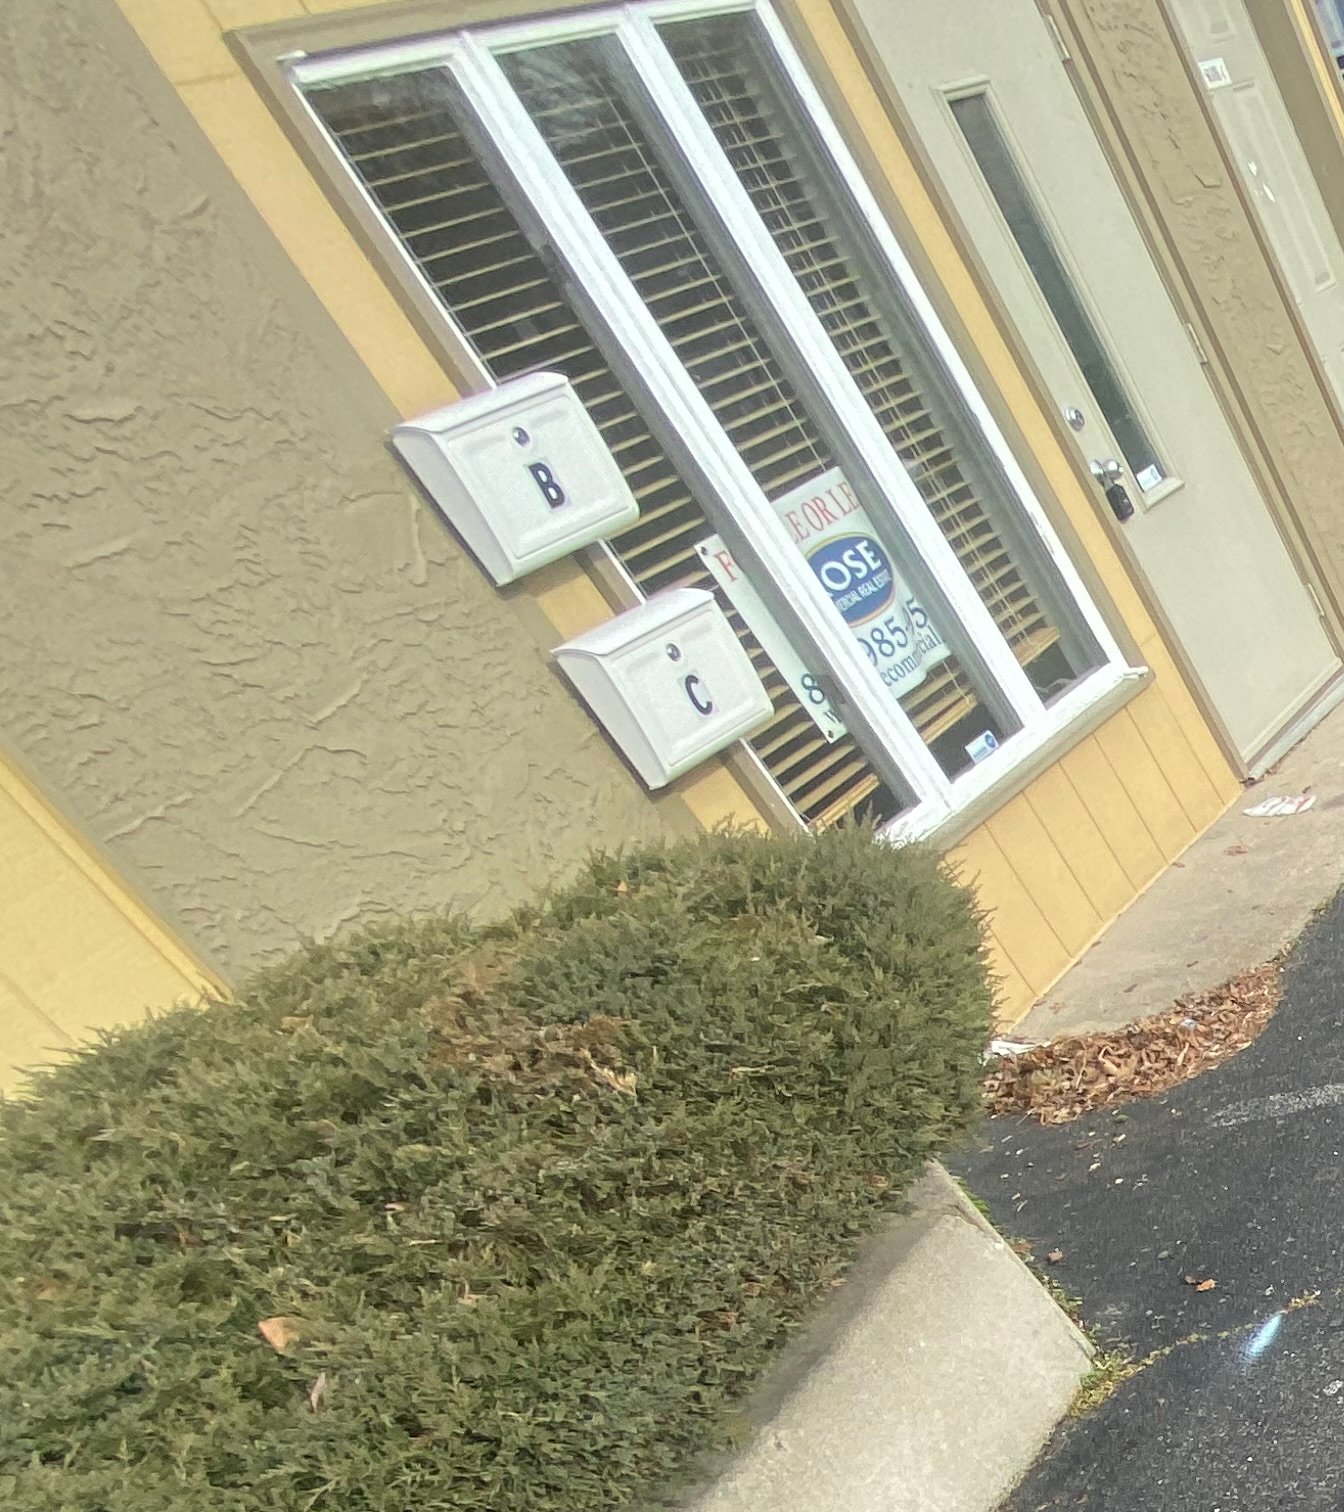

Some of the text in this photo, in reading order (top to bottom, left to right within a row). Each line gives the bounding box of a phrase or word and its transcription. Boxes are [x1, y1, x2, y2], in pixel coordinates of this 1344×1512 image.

[529, 462, 565, 509] B
[801, 495, 839, 531] OR
[821, 539, 882, 597] OSE
[685, 675, 713, 716] C
